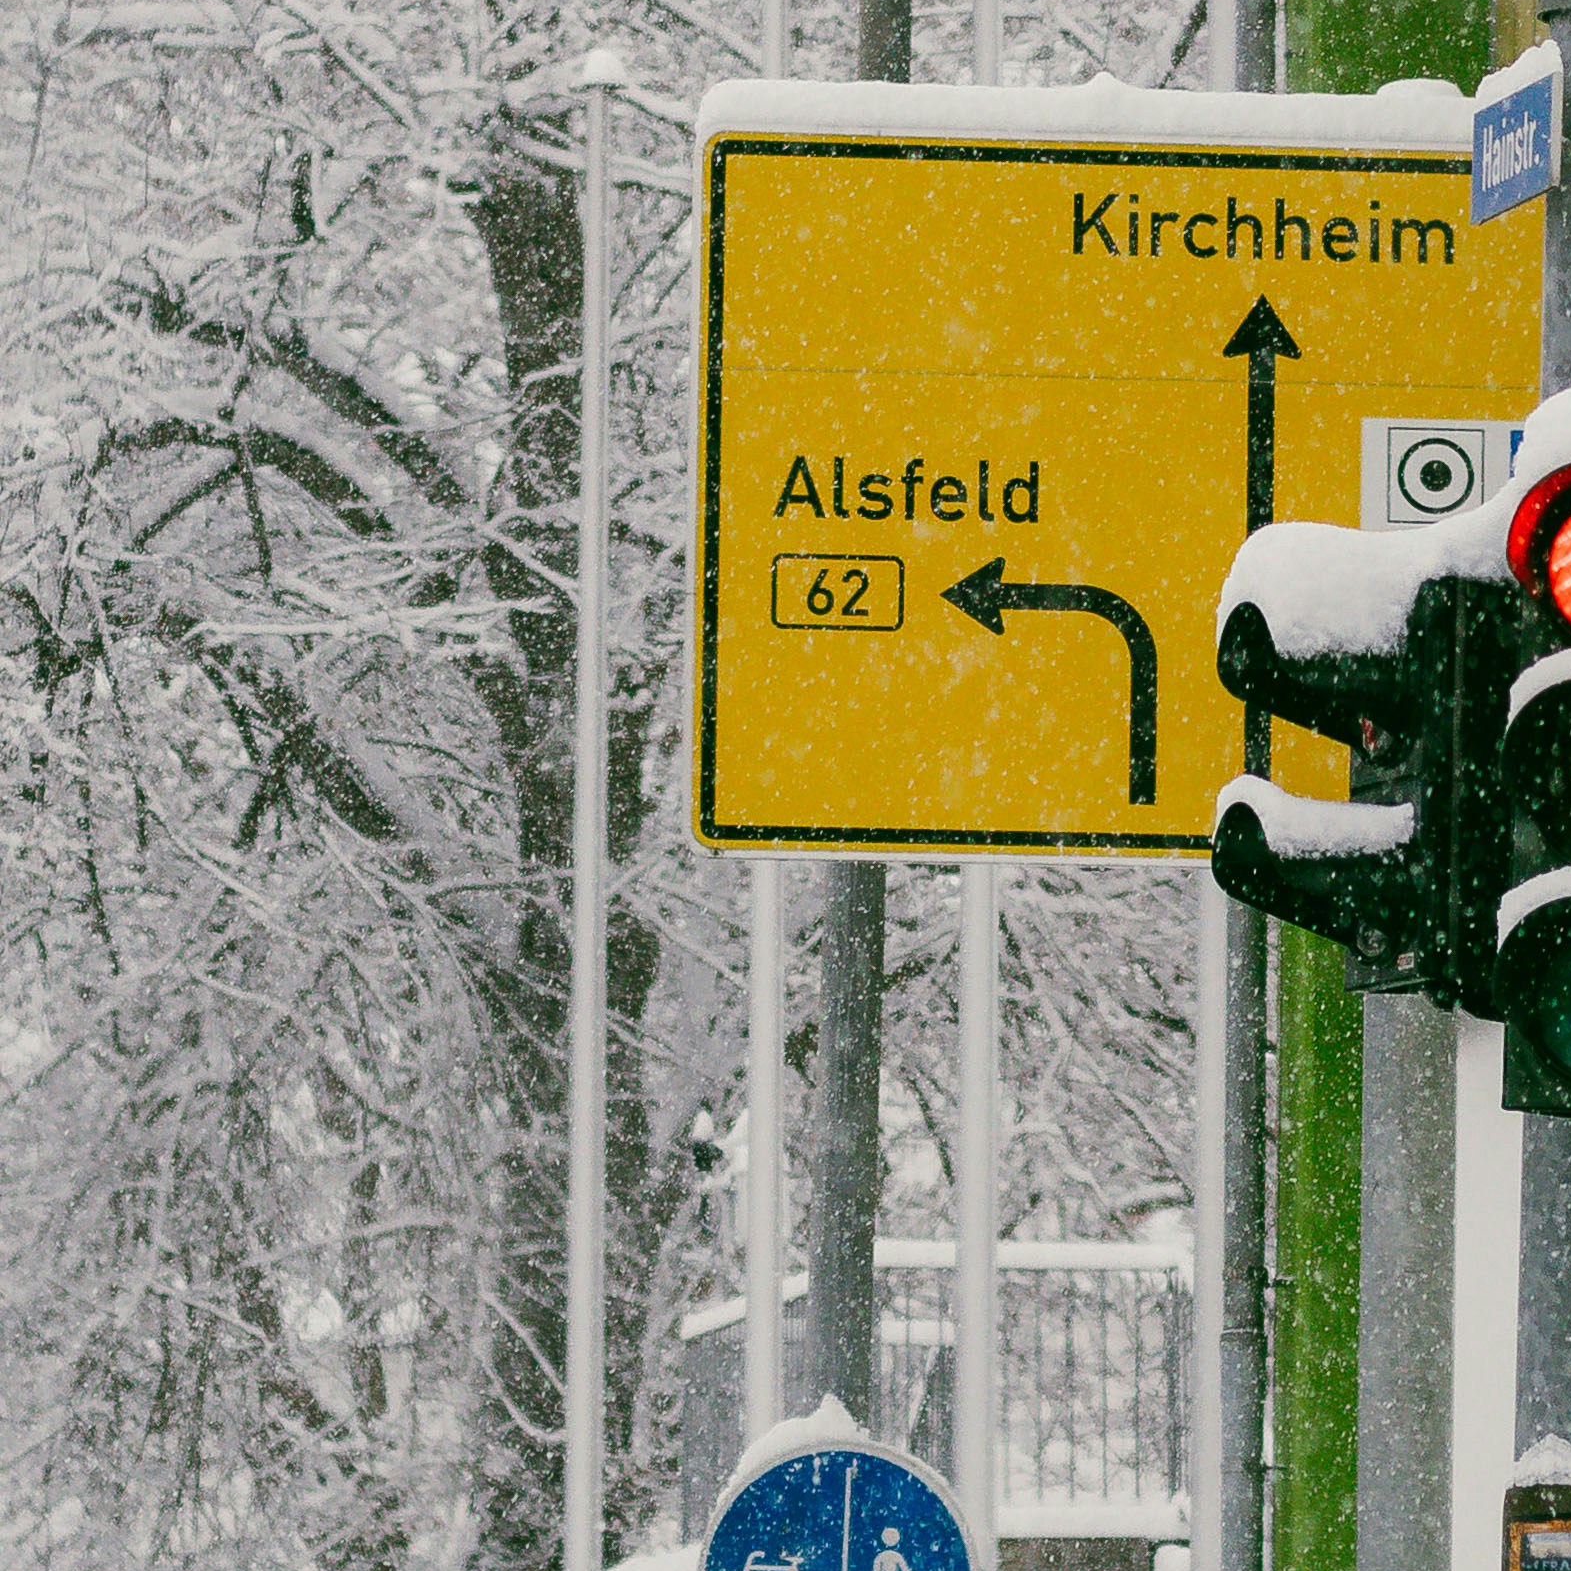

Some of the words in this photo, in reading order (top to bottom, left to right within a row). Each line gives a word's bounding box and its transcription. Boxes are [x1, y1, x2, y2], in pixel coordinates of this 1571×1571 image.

[1482, 111, 1540, 192] Hainstr.
[1072, 192, 1456, 265] Kirchheim
[773, 455, 1041, 524] Alsfeld
[805, 569, 871, 617] 62
